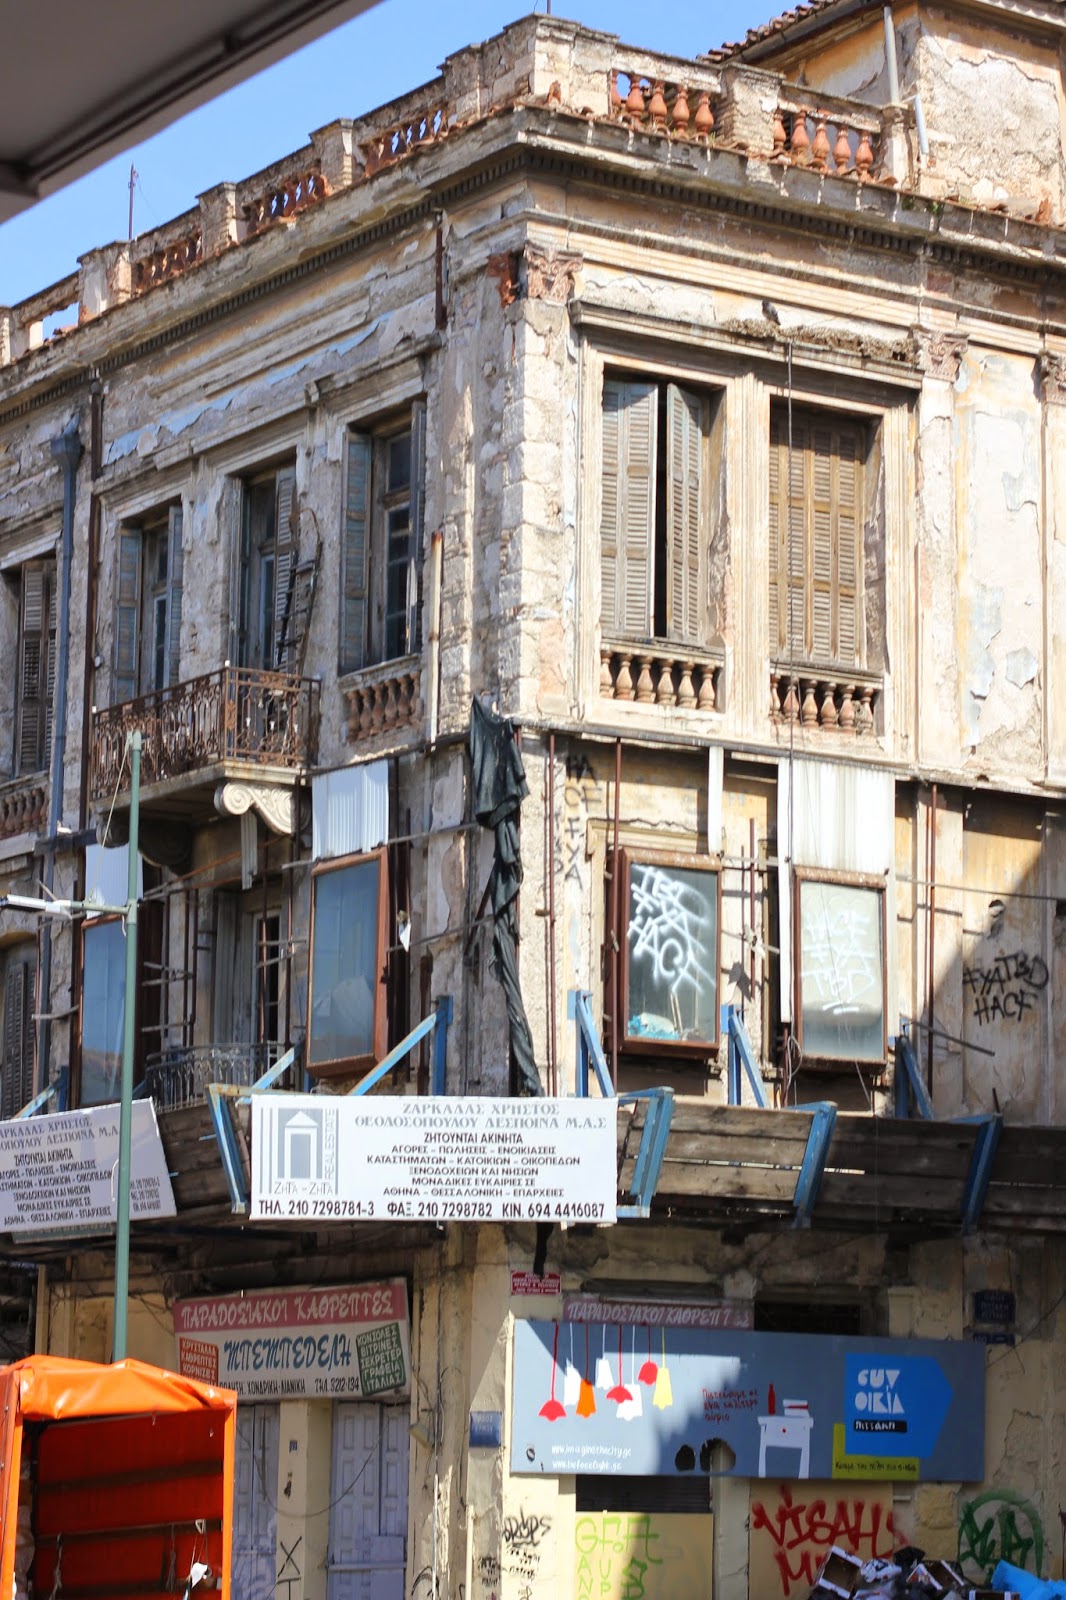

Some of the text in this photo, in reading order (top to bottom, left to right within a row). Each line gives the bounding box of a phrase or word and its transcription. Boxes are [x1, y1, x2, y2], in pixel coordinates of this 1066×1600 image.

[491, 1103, 560, 1116] ΧΡΗΣΤΟΣ
[424, 1132, 523, 1145] ΖΗΤΟΥΝΤΑΙ ΑΚΙΝΗΤΑ
[391, 1145, 556, 1155] ΑΓΟΡΕΣ ΠΩΛΗΣΕΙΣ ΕΝΟΙΚΙΑΣΕΙΣ
[367, 1156, 580, 1166] ΚΑΤΑΣΤΗΜΑΤΩΝ ΚΑΤΟΙΚΙΩΝ ΟΙΚΟΠΕΔΩΝ
[482, 1167, 500, 1176] ΚΑΙ
[502, 1167, 539, 1177] ΝΗΣΙΩΝ
[412, 1177, 536, 1187] ΜΟΝΑΔΙΚΕΣ ΕΥΚΑΙΡΙΕΣ ΣΕ
[383, 1188, 564, 1198] ΑΘΗΝΑ ΘΕΣΣΑΛΟΝΙΚΗ ΕΠΑΡΧΕΙΕΣ
[259, 1200, 605, 1219] ΤΗΛ. 210 7298781-3 ΦΑΞ. 210 7298782 ΚΙΝ. 694 4416087
